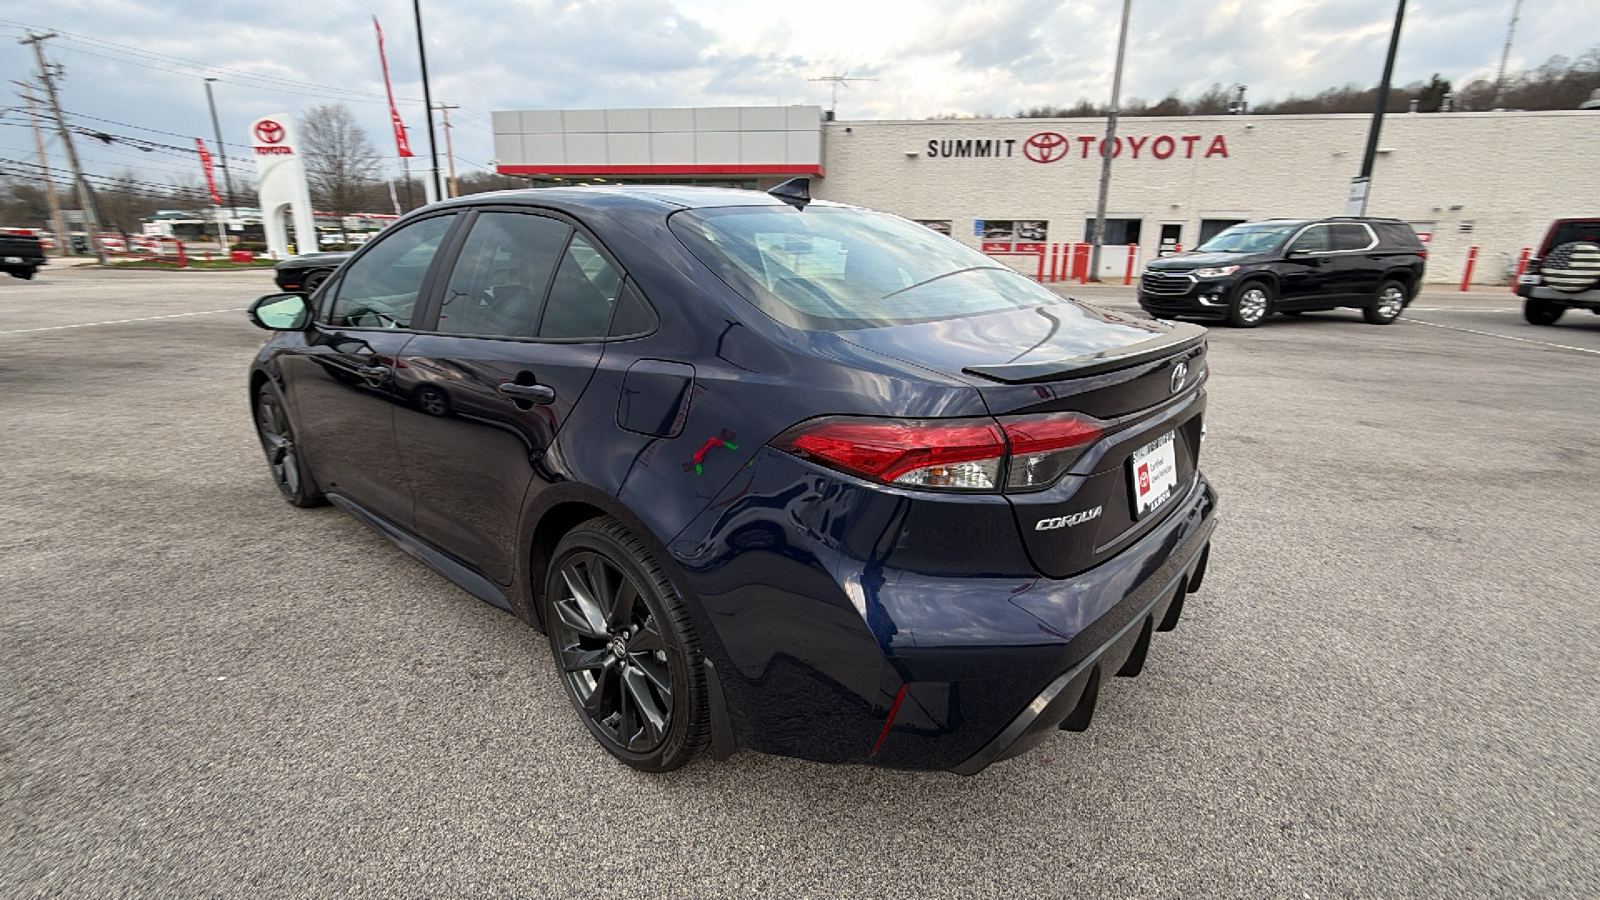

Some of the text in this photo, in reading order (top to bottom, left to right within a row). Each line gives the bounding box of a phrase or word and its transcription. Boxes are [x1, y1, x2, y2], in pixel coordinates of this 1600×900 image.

[927, 134, 1229, 159] SUMMIT TOYOTA
[1035, 505, 1102, 530] COROLLA
